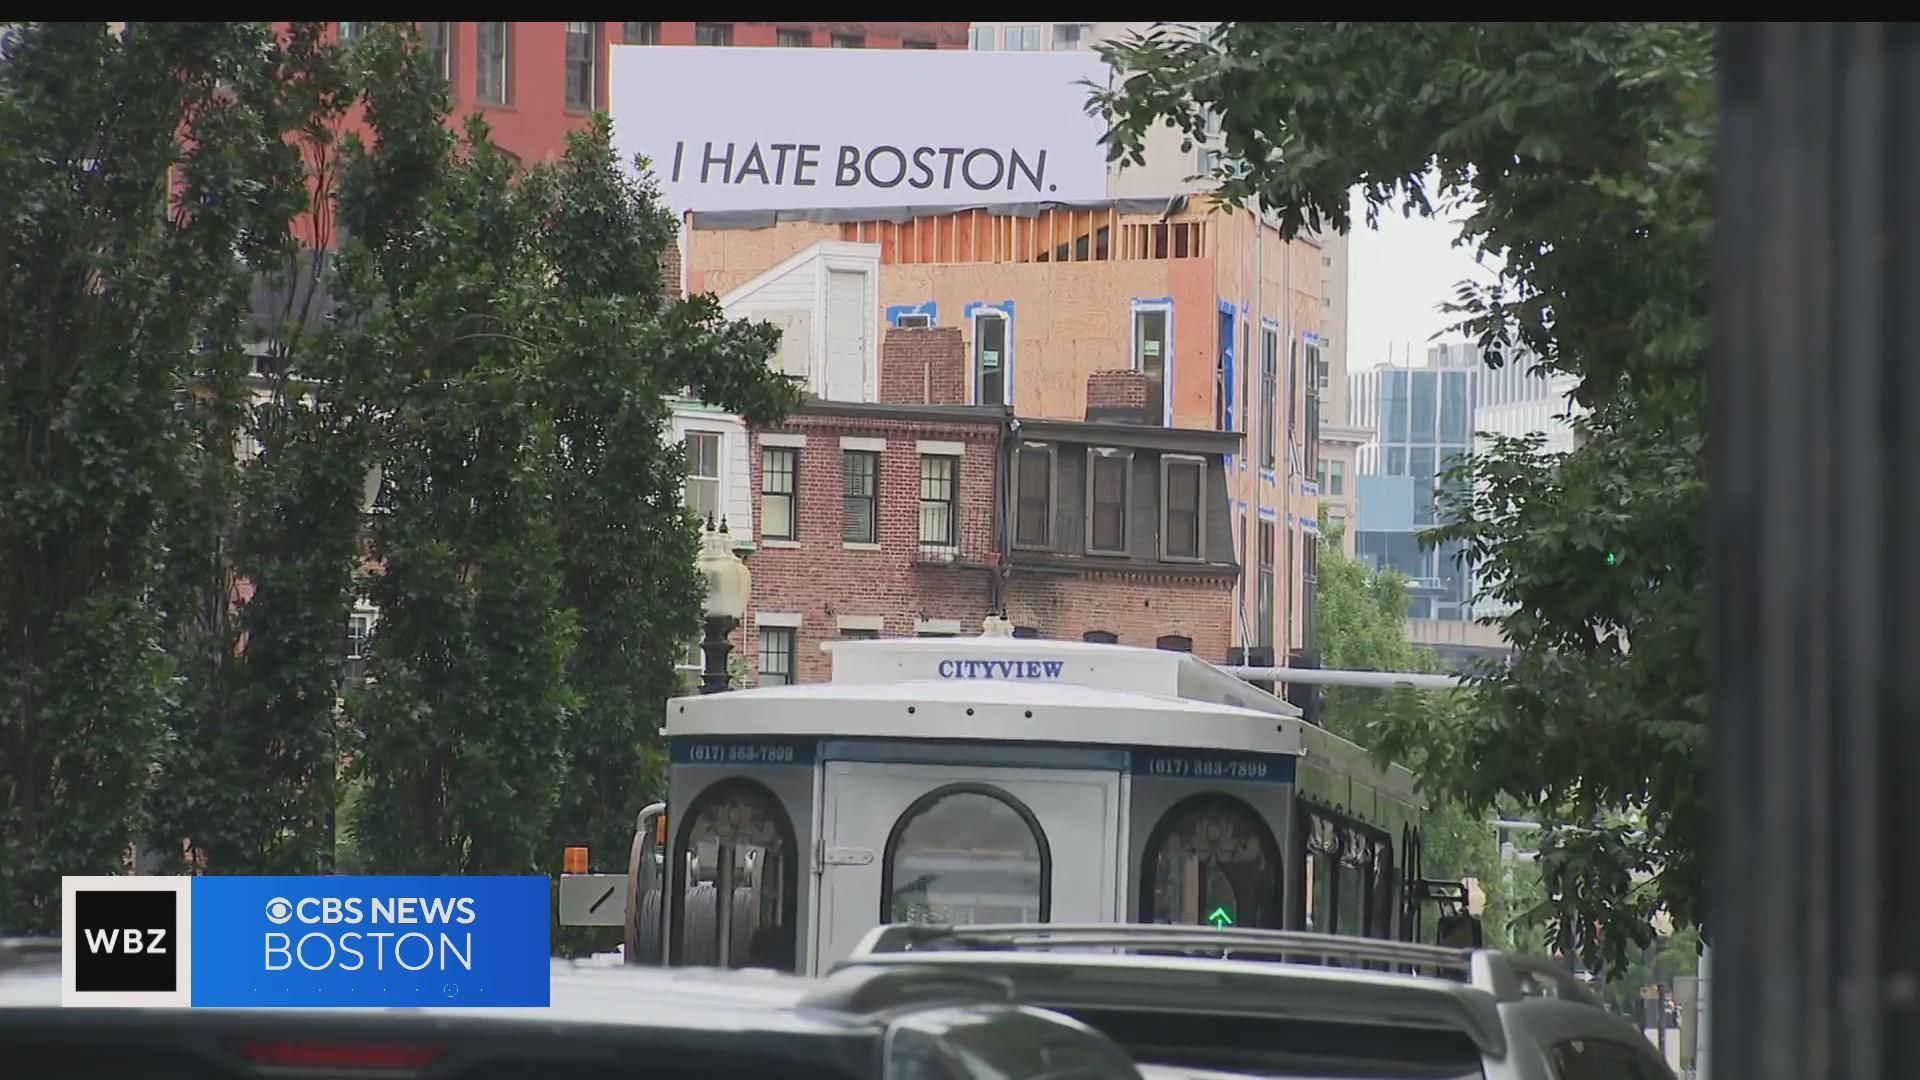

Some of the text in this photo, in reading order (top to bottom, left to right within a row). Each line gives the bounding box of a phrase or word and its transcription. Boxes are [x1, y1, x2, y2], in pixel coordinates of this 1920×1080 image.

[672, 141, 1058, 193] I HATE BOSTON.
[938, 659, 1064, 678] CITYVIEW
[689, 744, 725, 761] (617)
[1149, 758, 1189, 776] (617)
